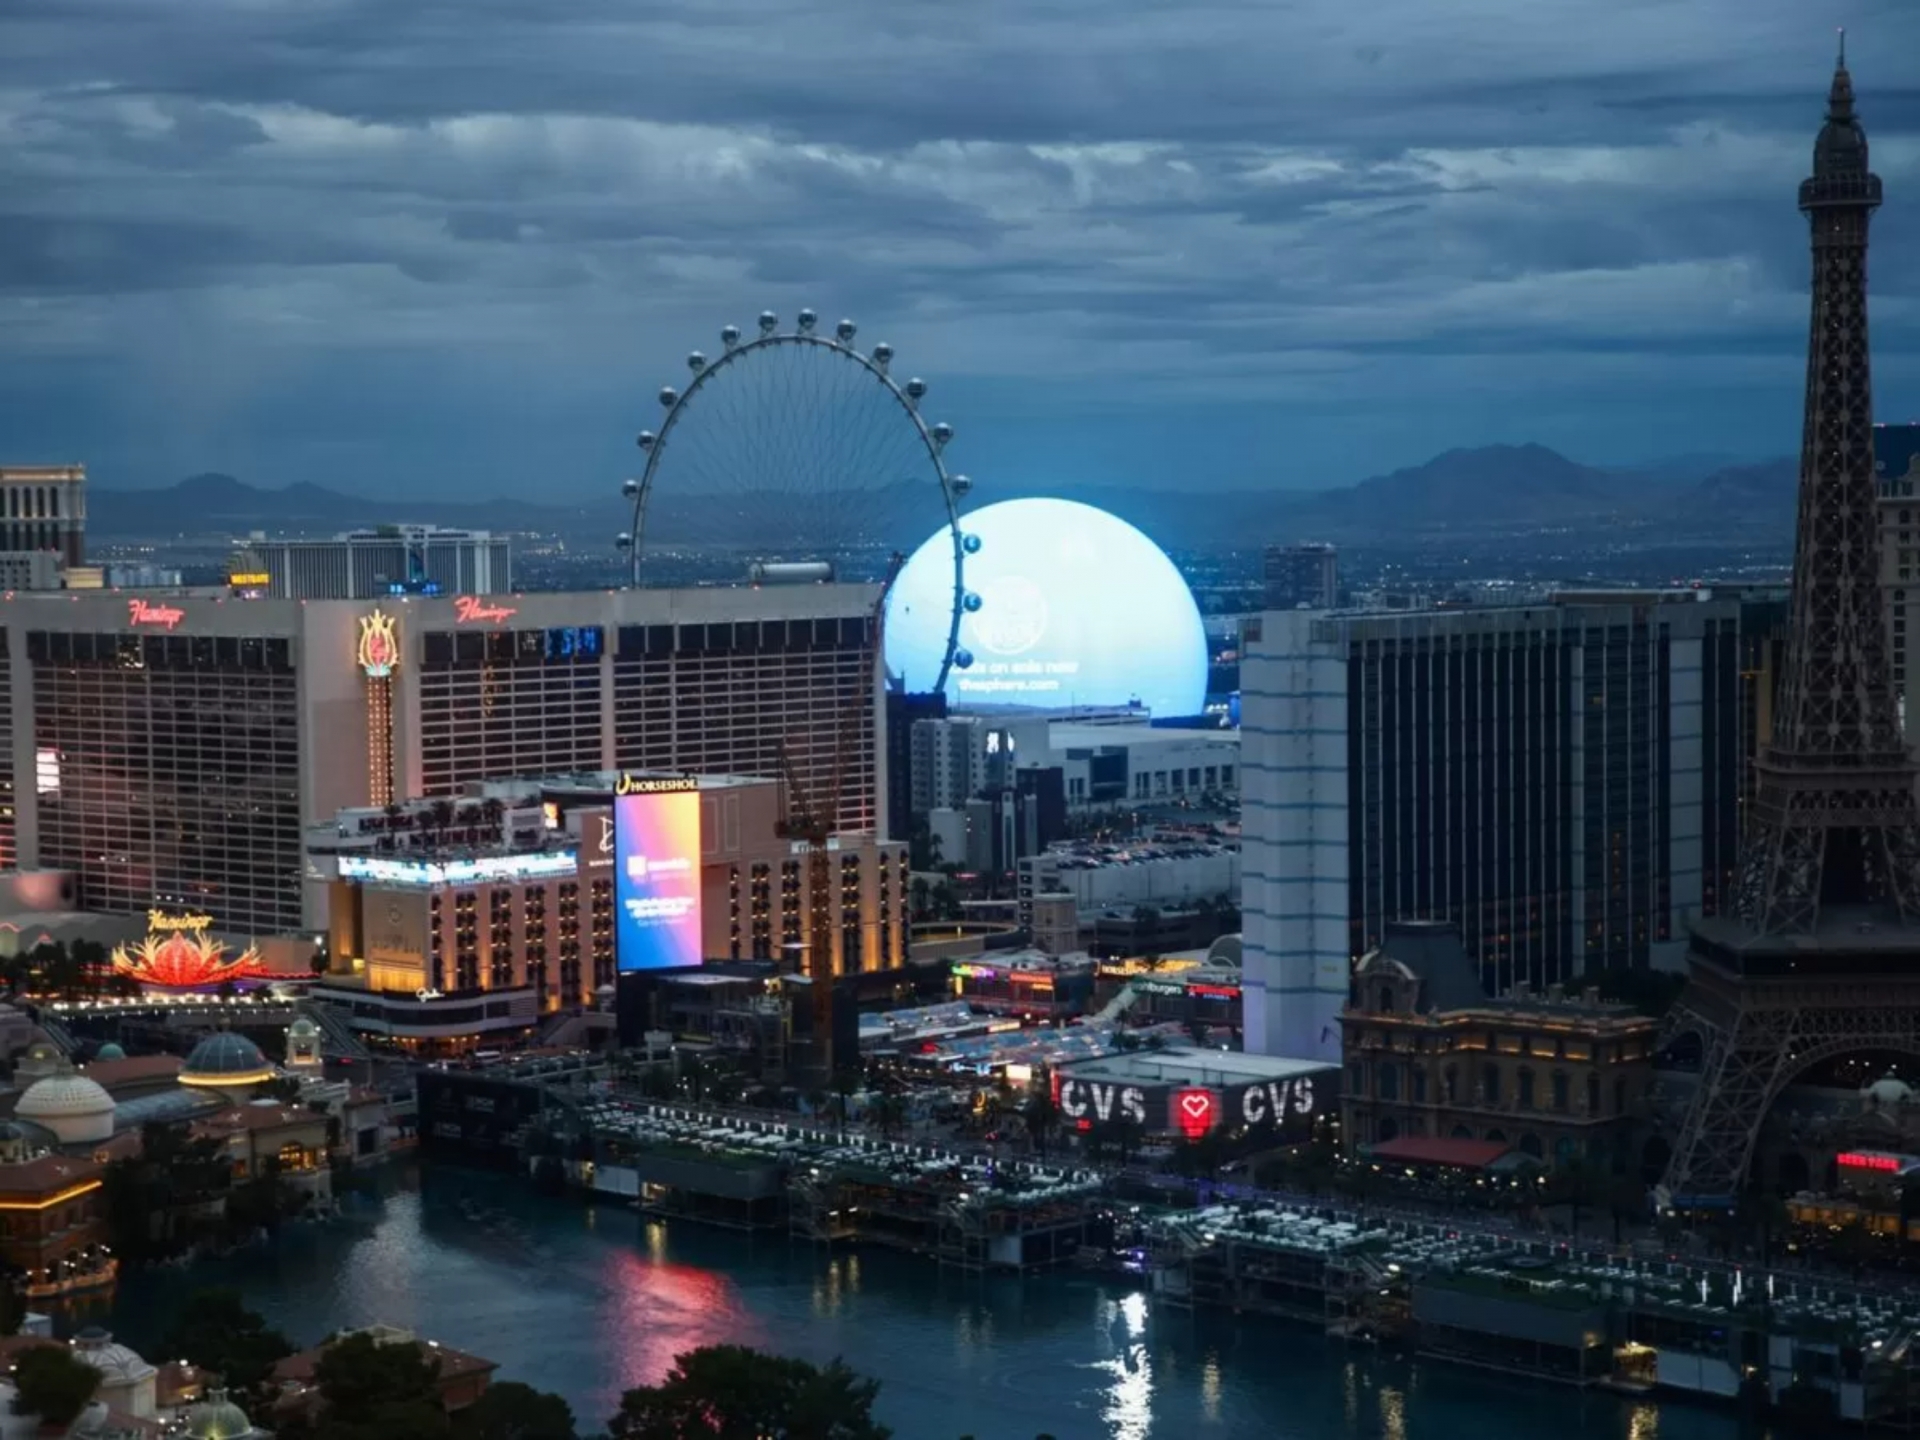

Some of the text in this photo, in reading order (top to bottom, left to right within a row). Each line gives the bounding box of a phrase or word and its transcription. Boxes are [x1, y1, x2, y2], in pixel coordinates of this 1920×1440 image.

[128, 599, 185, 630] Flamingo
[1061, 1080, 1146, 1124] CVS
[1242, 1076, 1314, 1123] CVS
